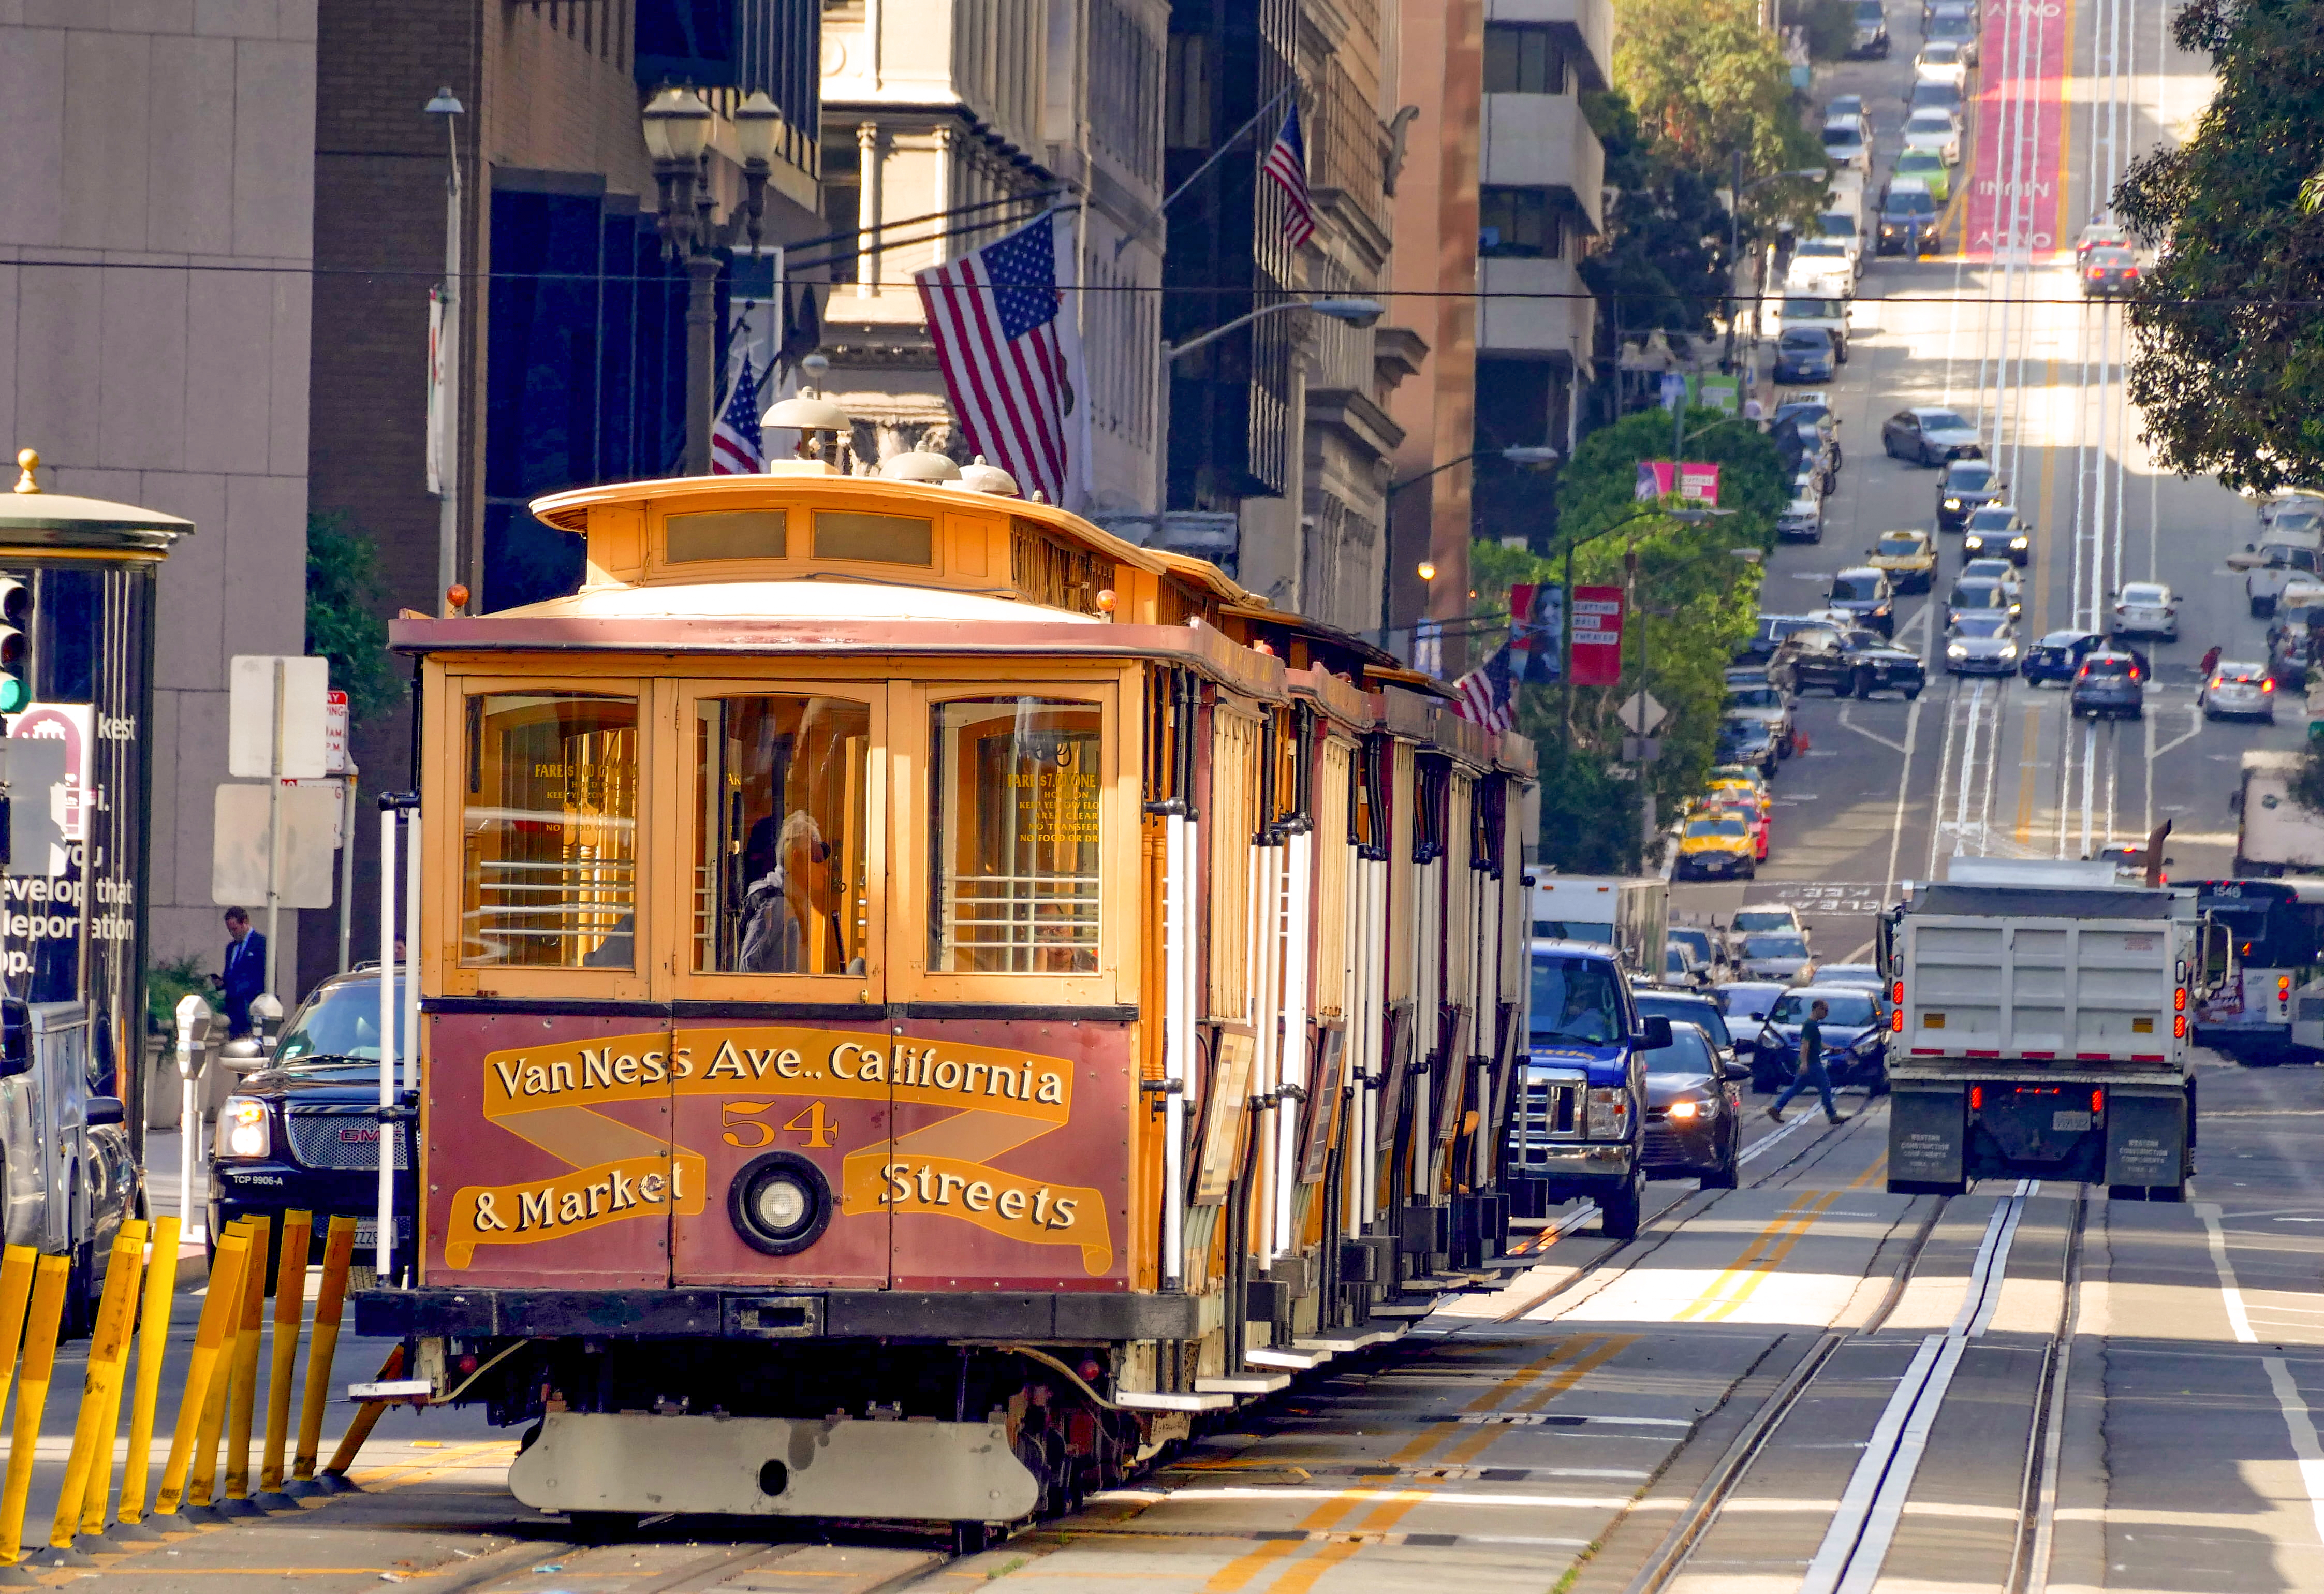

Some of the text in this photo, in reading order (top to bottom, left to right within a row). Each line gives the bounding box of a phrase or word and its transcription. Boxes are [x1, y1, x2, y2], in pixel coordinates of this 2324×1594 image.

[98, 712, 136, 740] kest
[95, 877, 133, 904] that
[4, 910, 134, 942] eporation
[493, 1058, 575, 1100] Van
[577, 1047, 693, 1090] Ness
[829, 1042, 1063, 1105] California
[722, 1099, 839, 1148] 54
[233, 1175, 283, 1185] TCP 9906-A
[474, 1162, 684, 1232] & Market
[878, 1163, 1079, 1231] Streets
